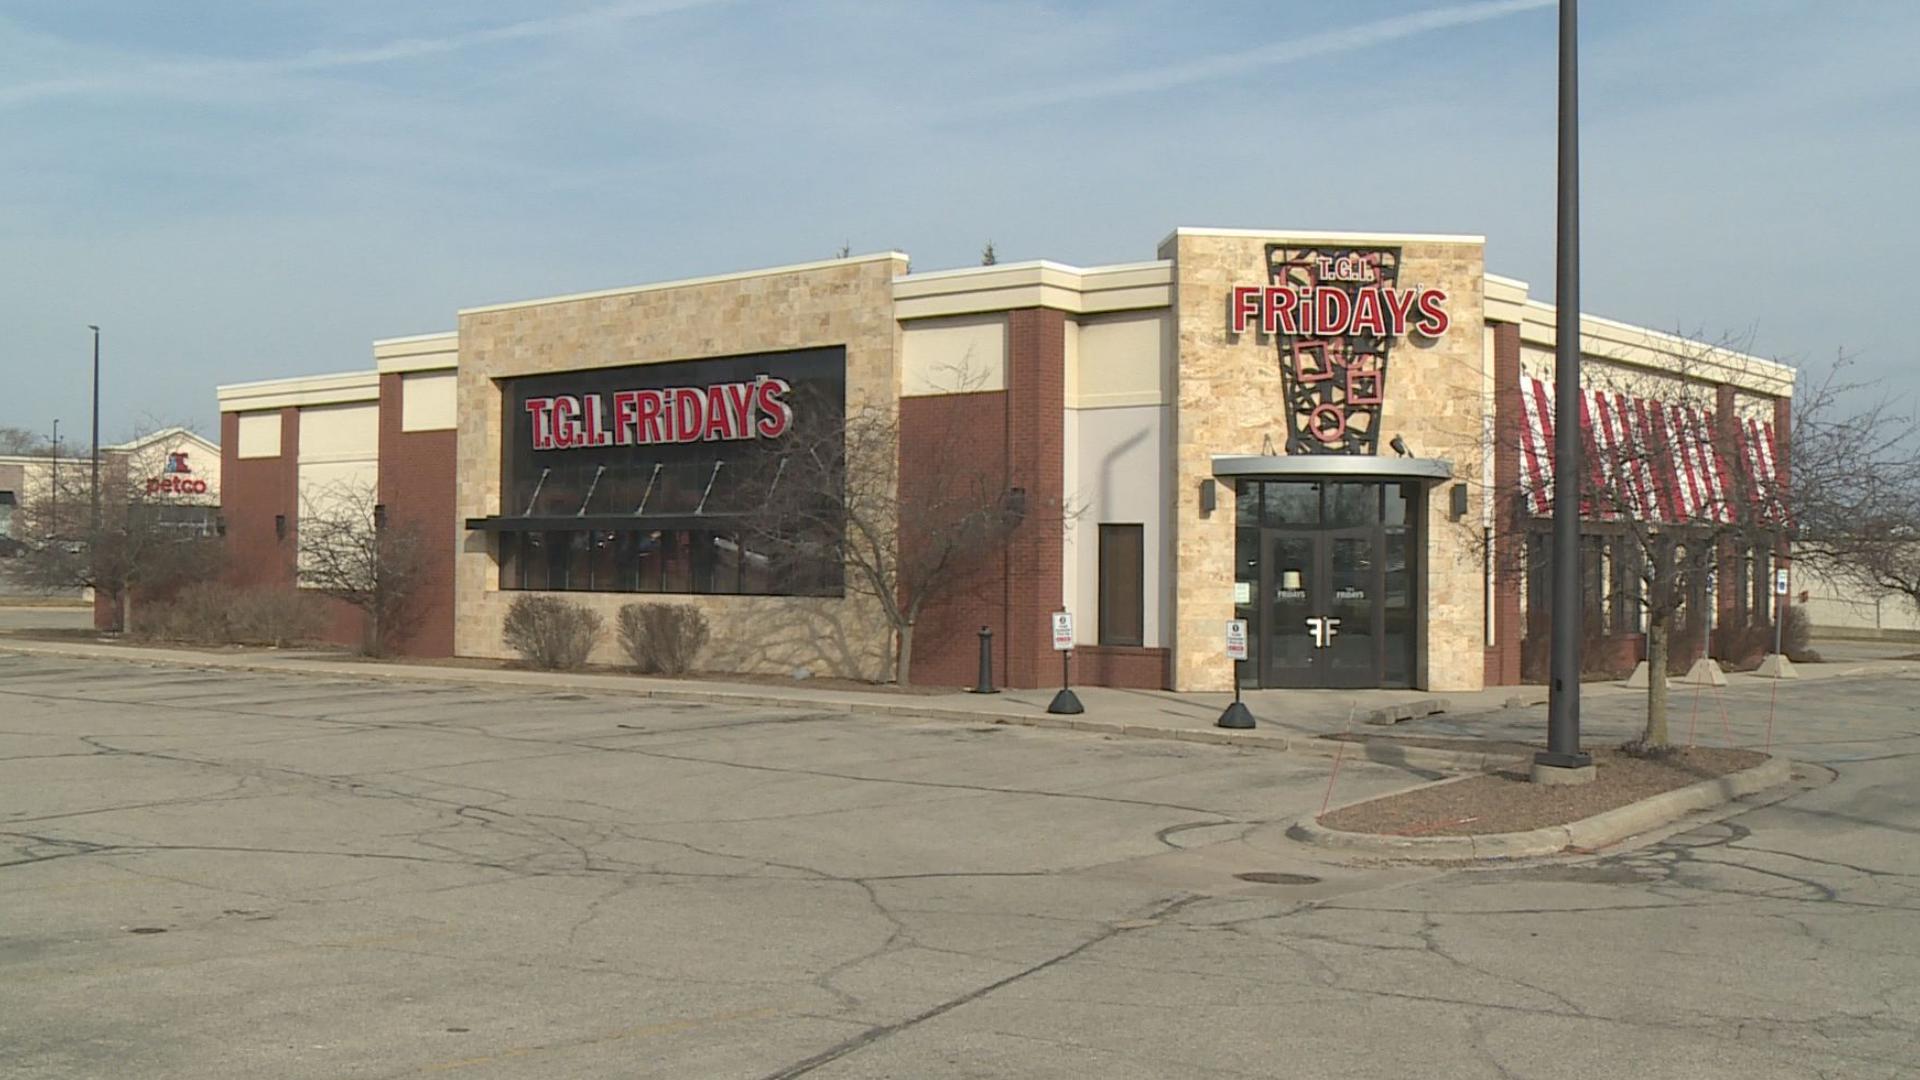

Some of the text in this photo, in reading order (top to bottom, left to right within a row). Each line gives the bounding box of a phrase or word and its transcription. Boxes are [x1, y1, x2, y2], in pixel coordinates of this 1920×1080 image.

[1316, 257, 1375, 282] T.G.I.
[526, 393, 613, 450] T.G.I.
[146, 475, 207, 496] petco
